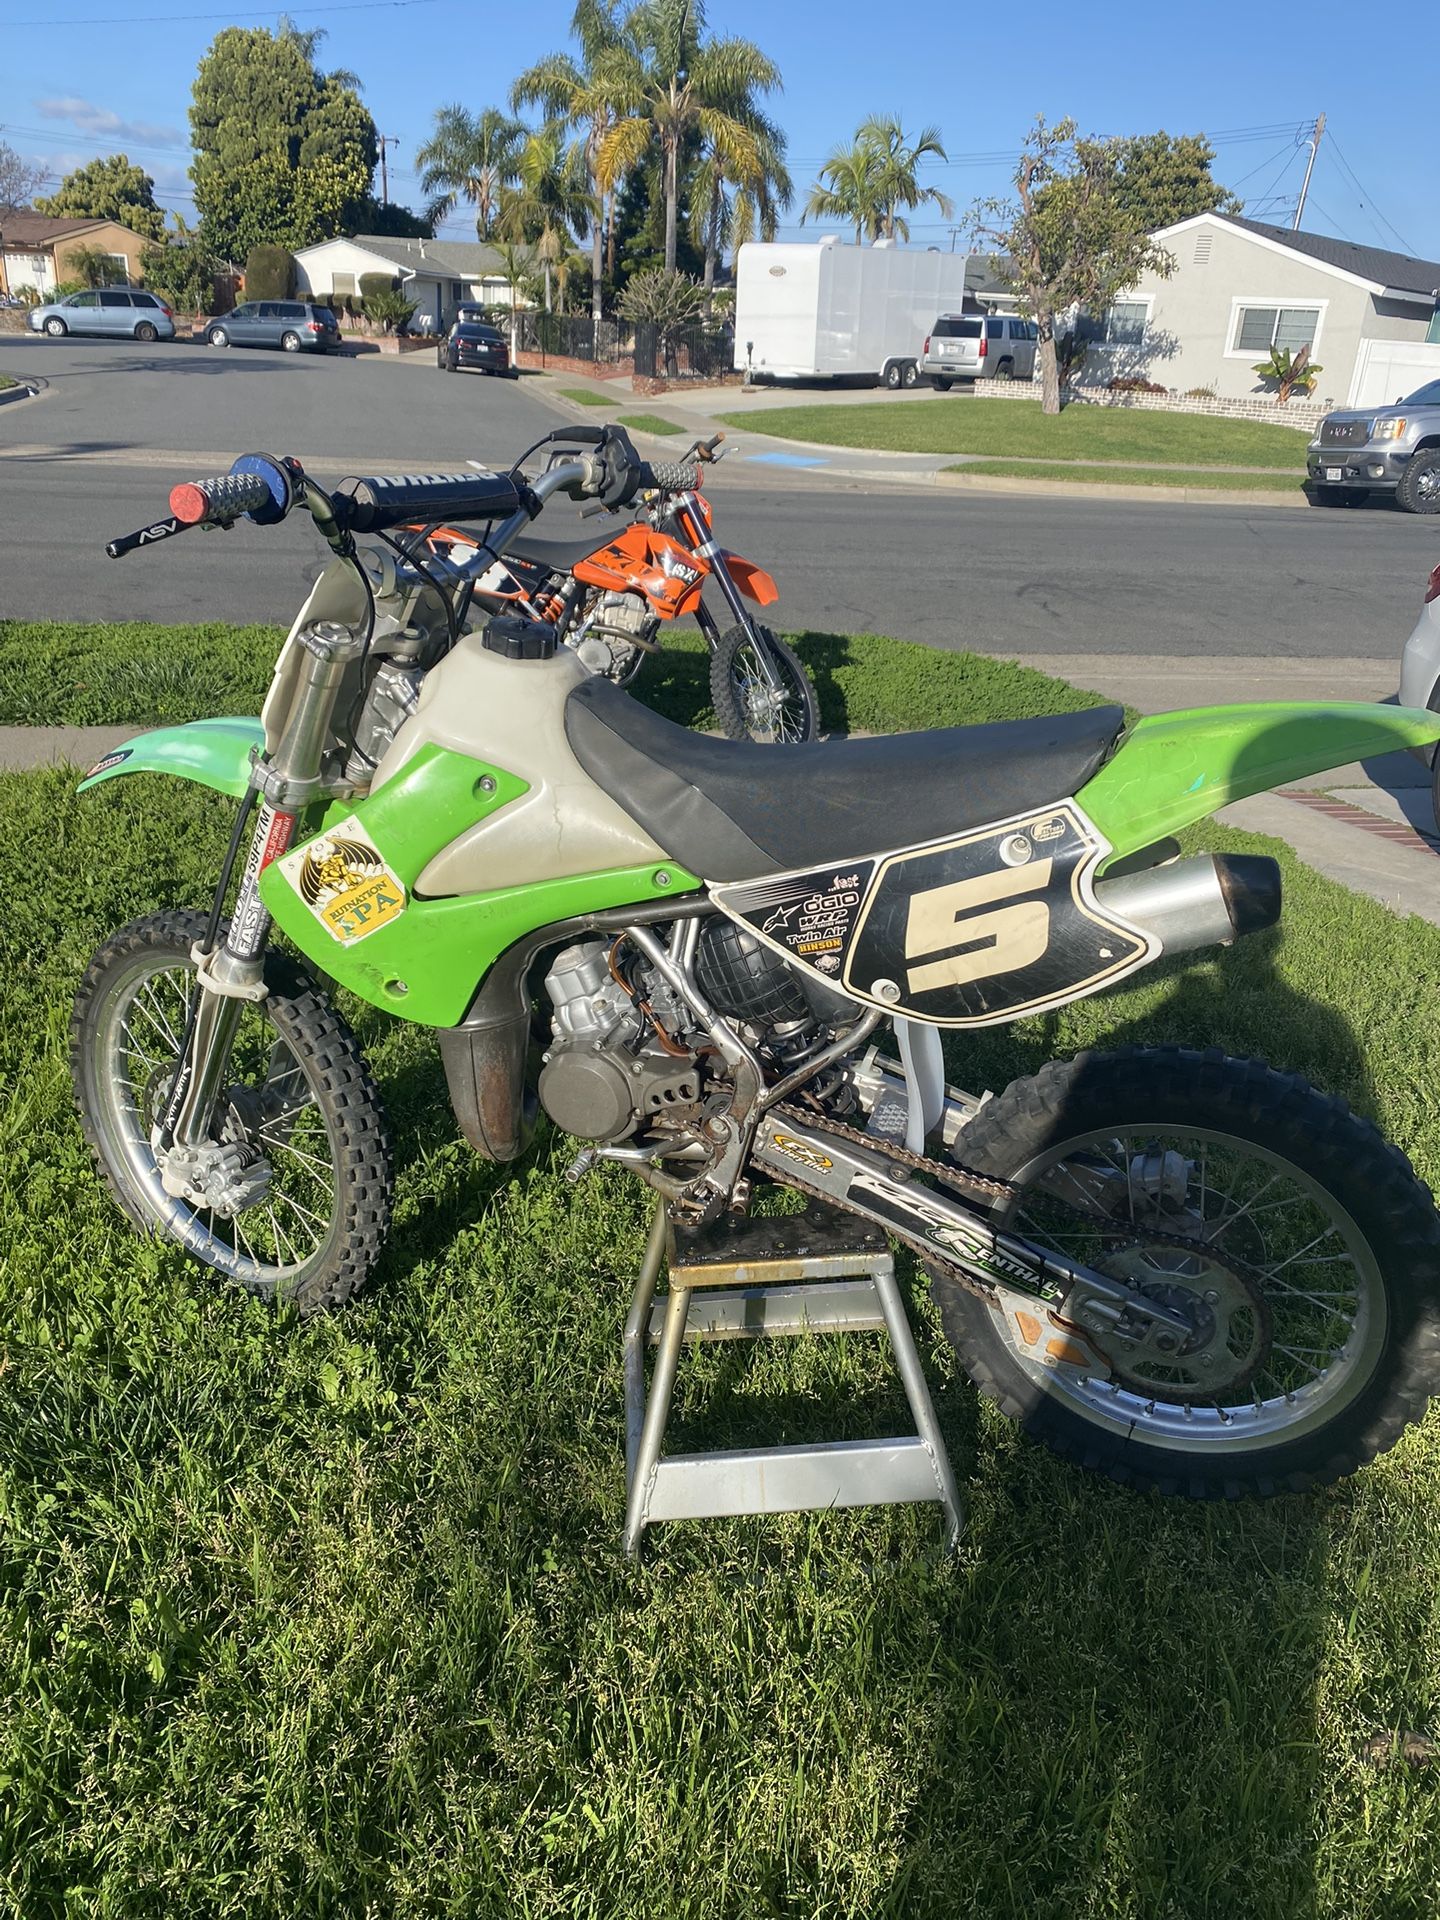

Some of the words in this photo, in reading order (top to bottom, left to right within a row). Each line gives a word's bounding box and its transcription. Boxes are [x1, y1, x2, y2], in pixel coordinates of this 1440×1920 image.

[139, 520, 177, 544] ASV
[250, 808, 271, 873] 59P47M
[266, 818, 284, 860] CALIFORNIA
[278, 816, 292, 850] HIGHWAY
[329, 880, 388, 920] RUINATION
[799, 908, 848, 927] WRP
[905, 857, 1053, 994] 5
[787, 931, 821, 945] Twin
[823, 926, 848, 939] Air
[800, 938, 841, 953] HINSON
